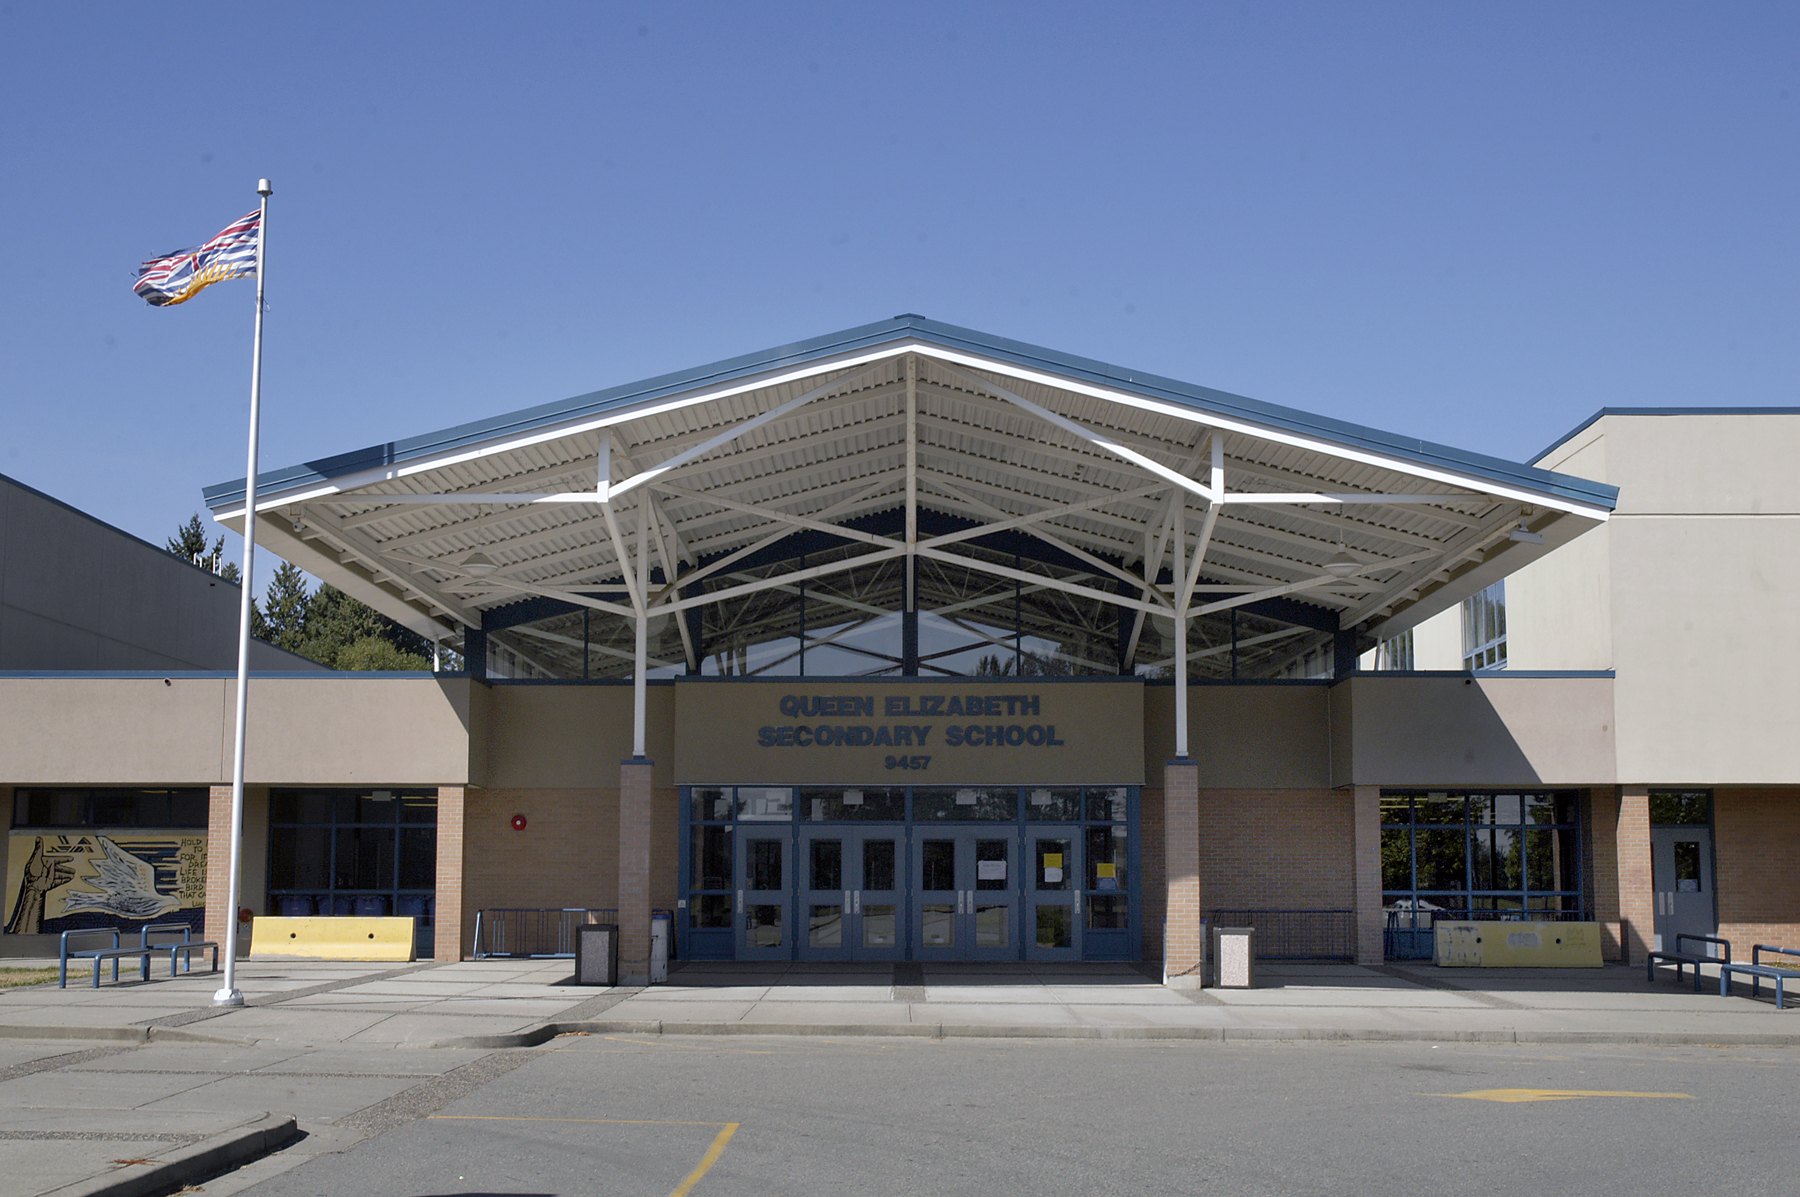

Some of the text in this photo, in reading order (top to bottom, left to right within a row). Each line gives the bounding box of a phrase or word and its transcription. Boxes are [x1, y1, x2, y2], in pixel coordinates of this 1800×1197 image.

[779, 695, 1040, 718] QUEEN ELIZABETH
[757, 725, 1065, 747] SECONDARY SCHOOL
[884, 755, 932, 770] 9457
[181, 838, 202, 847] HOLD
[180, 853, 197, 861] FOR
[180, 867, 197, 876] LIFE
[185, 883, 204, 891] BIRD
[179, 891, 197, 899] THAT
